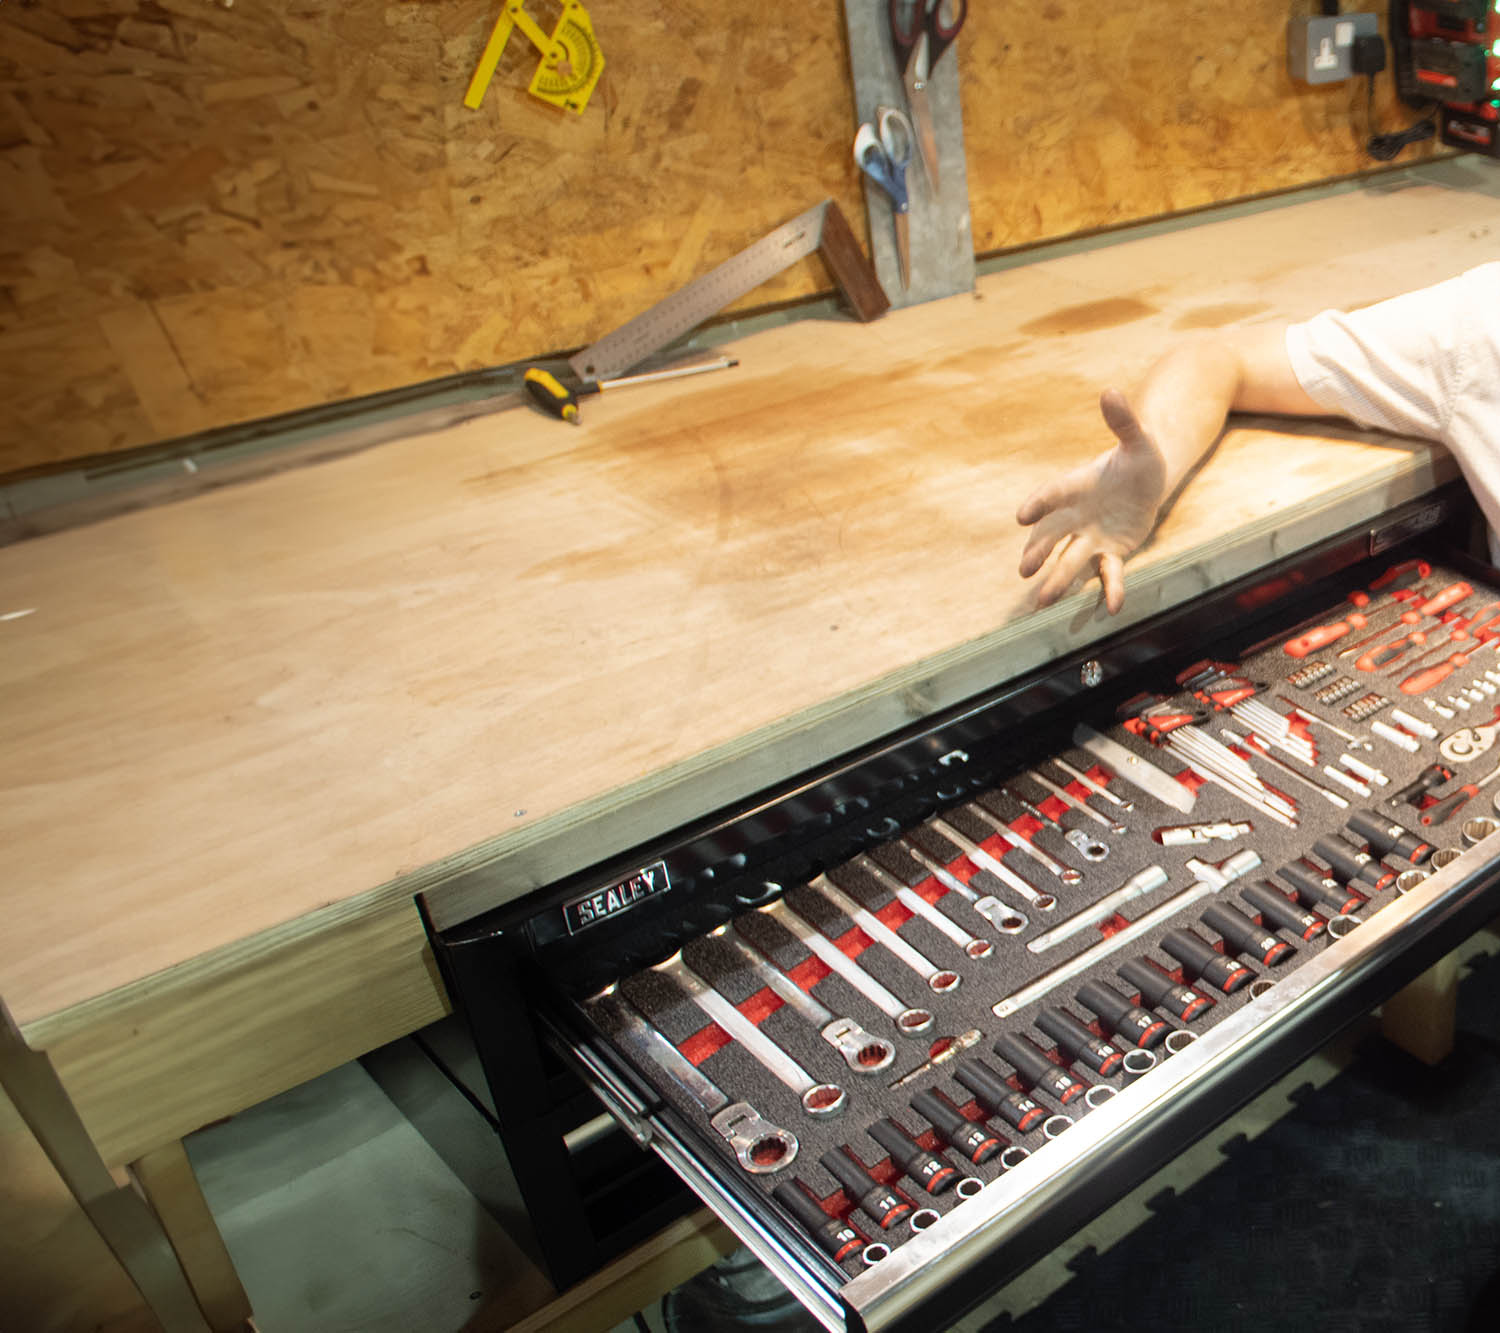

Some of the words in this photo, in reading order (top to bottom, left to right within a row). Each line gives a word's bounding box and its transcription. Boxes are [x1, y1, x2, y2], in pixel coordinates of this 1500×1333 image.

[578, 871, 655, 925] SEALEY
[1137, 1015, 1153, 1028] 17
[968, 1131, 985, 1146] 13
[923, 1161, 942, 1176] 12
[880, 1196, 896, 1210] 11
[837, 1229, 856, 1242] 10
